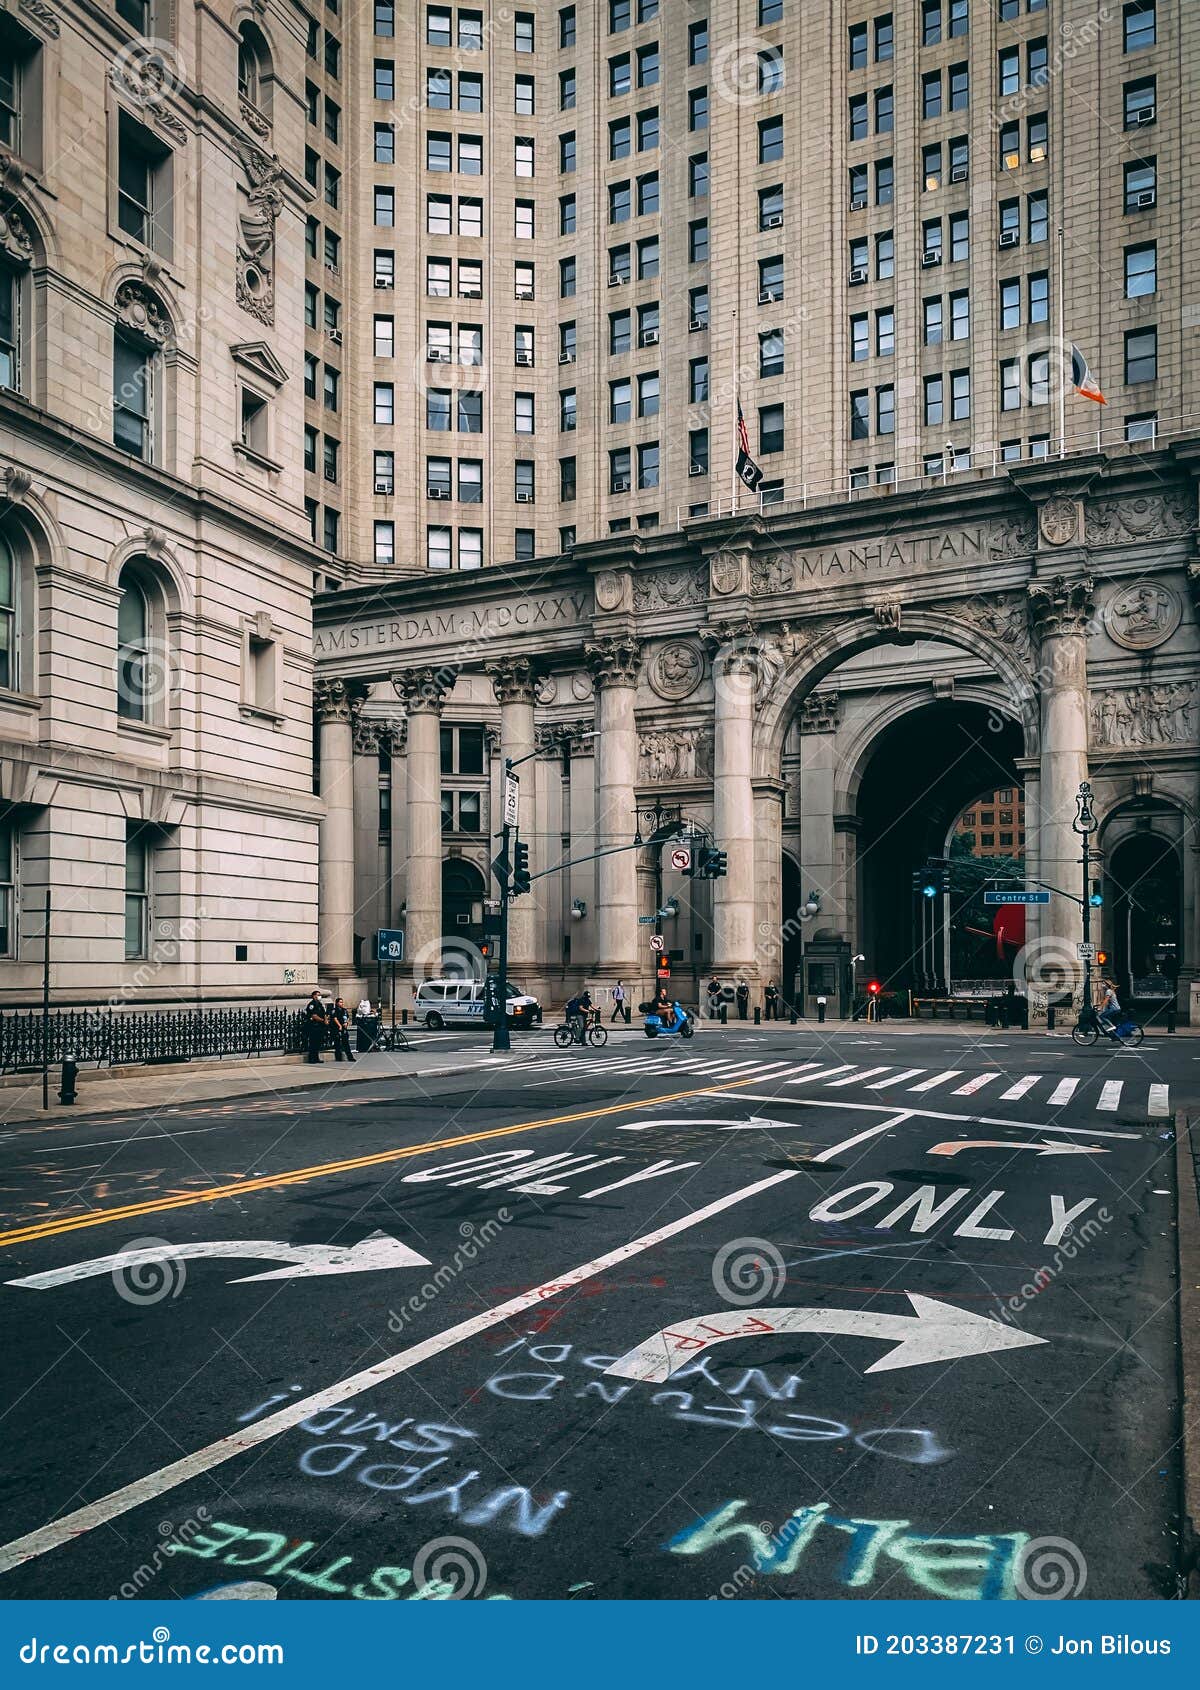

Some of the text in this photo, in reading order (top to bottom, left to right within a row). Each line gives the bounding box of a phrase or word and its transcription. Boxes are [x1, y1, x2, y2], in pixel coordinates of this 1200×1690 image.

[800, 529, 984, 580] MANHATTAN
[313, 596, 587, 653] AMSTERDAM MDCXXV
[995, 894, 1039, 902] Centre St
[390, 943, 399, 954] 9A
[400, 1149, 701, 1199] ONLY
[808, 1181, 1098, 1246] ONLY
[299, 1442, 570, 1537] NYPD
[661, 1498, 1030, 1600] BLM
